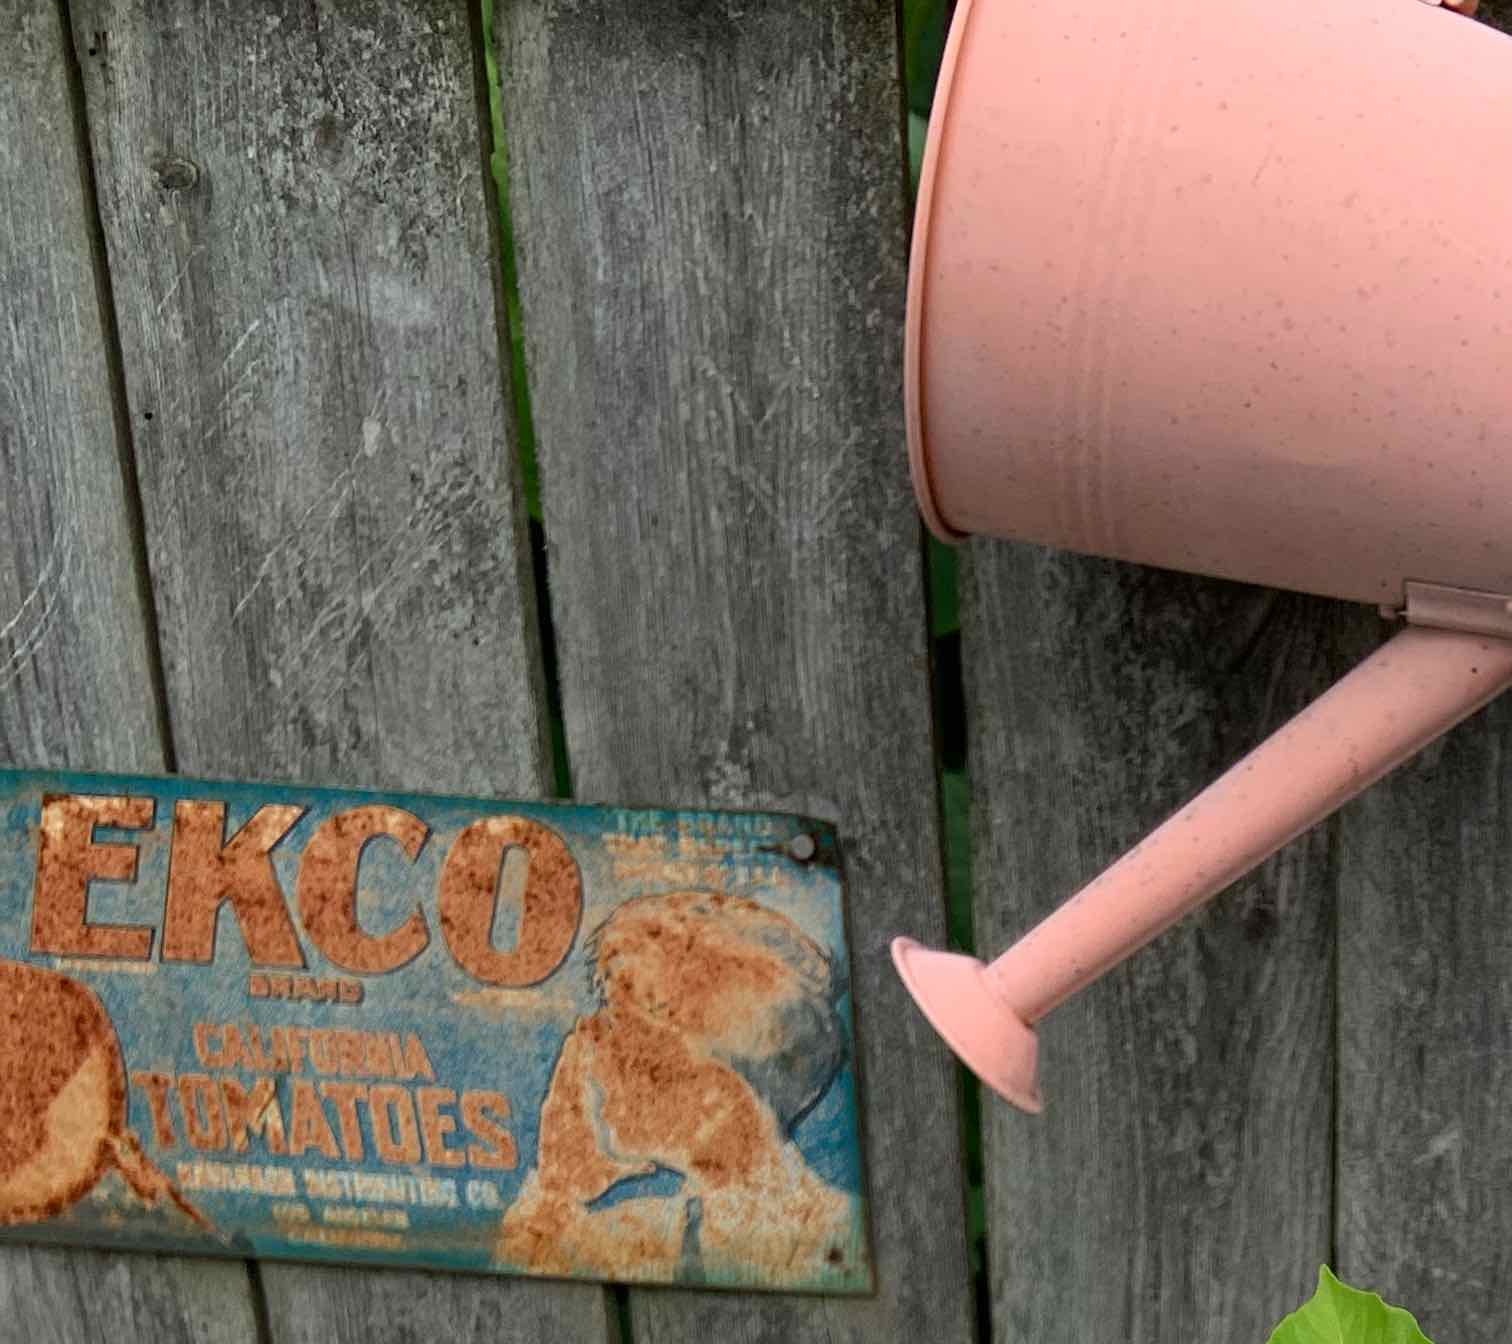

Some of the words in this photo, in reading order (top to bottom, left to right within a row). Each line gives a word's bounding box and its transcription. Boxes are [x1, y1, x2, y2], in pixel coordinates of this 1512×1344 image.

[30, 793, 584, 987] EKCO
[250, 974, 365, 1006] BRAND
[193, 1023, 437, 1083] CALIFORNIA
[131, 1071, 519, 1171] TOMATOES
